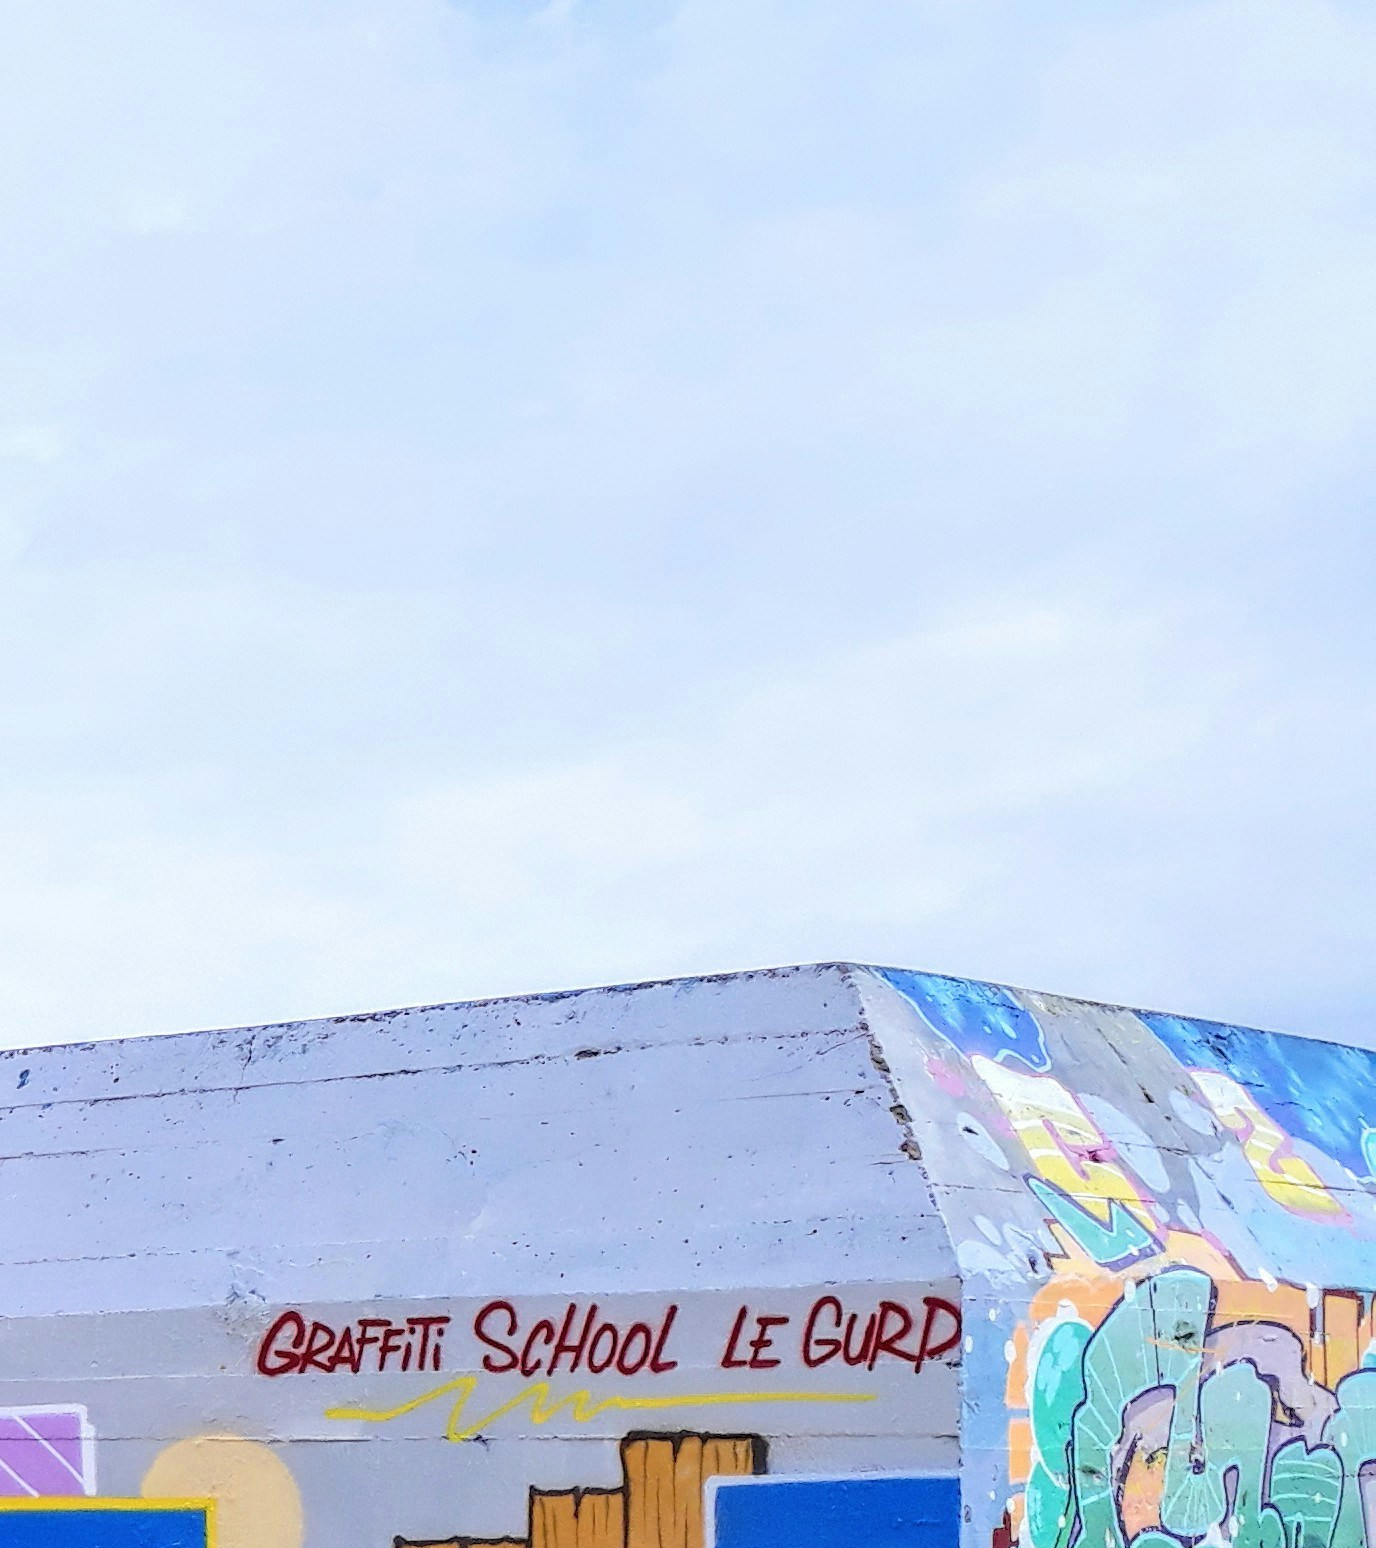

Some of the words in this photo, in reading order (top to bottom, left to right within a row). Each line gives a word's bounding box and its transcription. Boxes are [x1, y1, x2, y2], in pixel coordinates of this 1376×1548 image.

[473, 1300, 678, 1376] SCHOOL
[721, 1304, 790, 1371] LE
[800, 1295, 962, 1375] GURP
